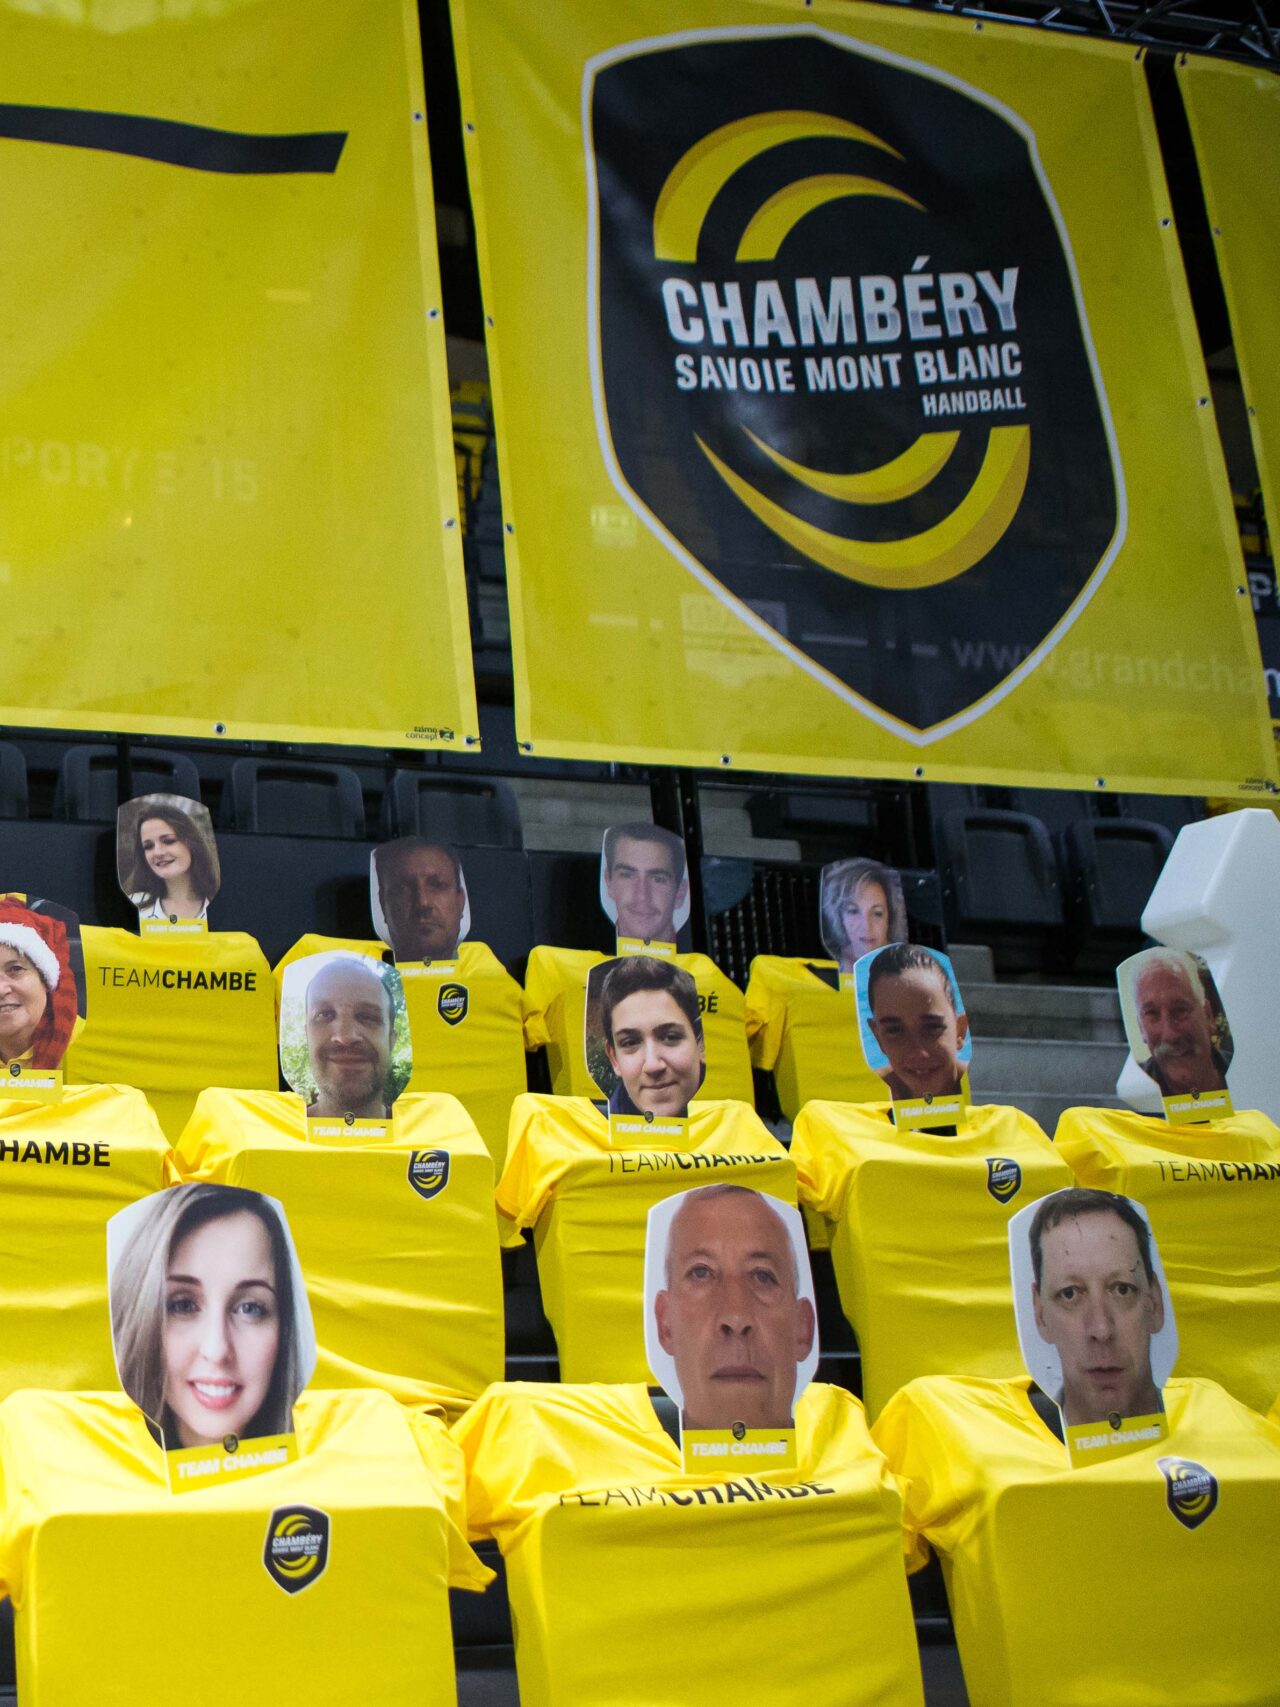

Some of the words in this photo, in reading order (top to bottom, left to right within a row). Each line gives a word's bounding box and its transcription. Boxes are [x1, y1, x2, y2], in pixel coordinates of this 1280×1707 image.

[661, 257, 1021, 347] CHAMBÉRY
[675, 351, 795, 393] SAVOIE
[806, 351, 901, 392] MONT
[914, 341, 1022, 384] BLANC
[922, 389, 1027, 417] HANDBALL
[98, 966, 257, 992] TEAMCHAMBÉ
[691, 1441, 728, 1456] TEAM
[1076, 1433, 1109, 1450] TEAM
[177, 1458, 220, 1479] TEAM
